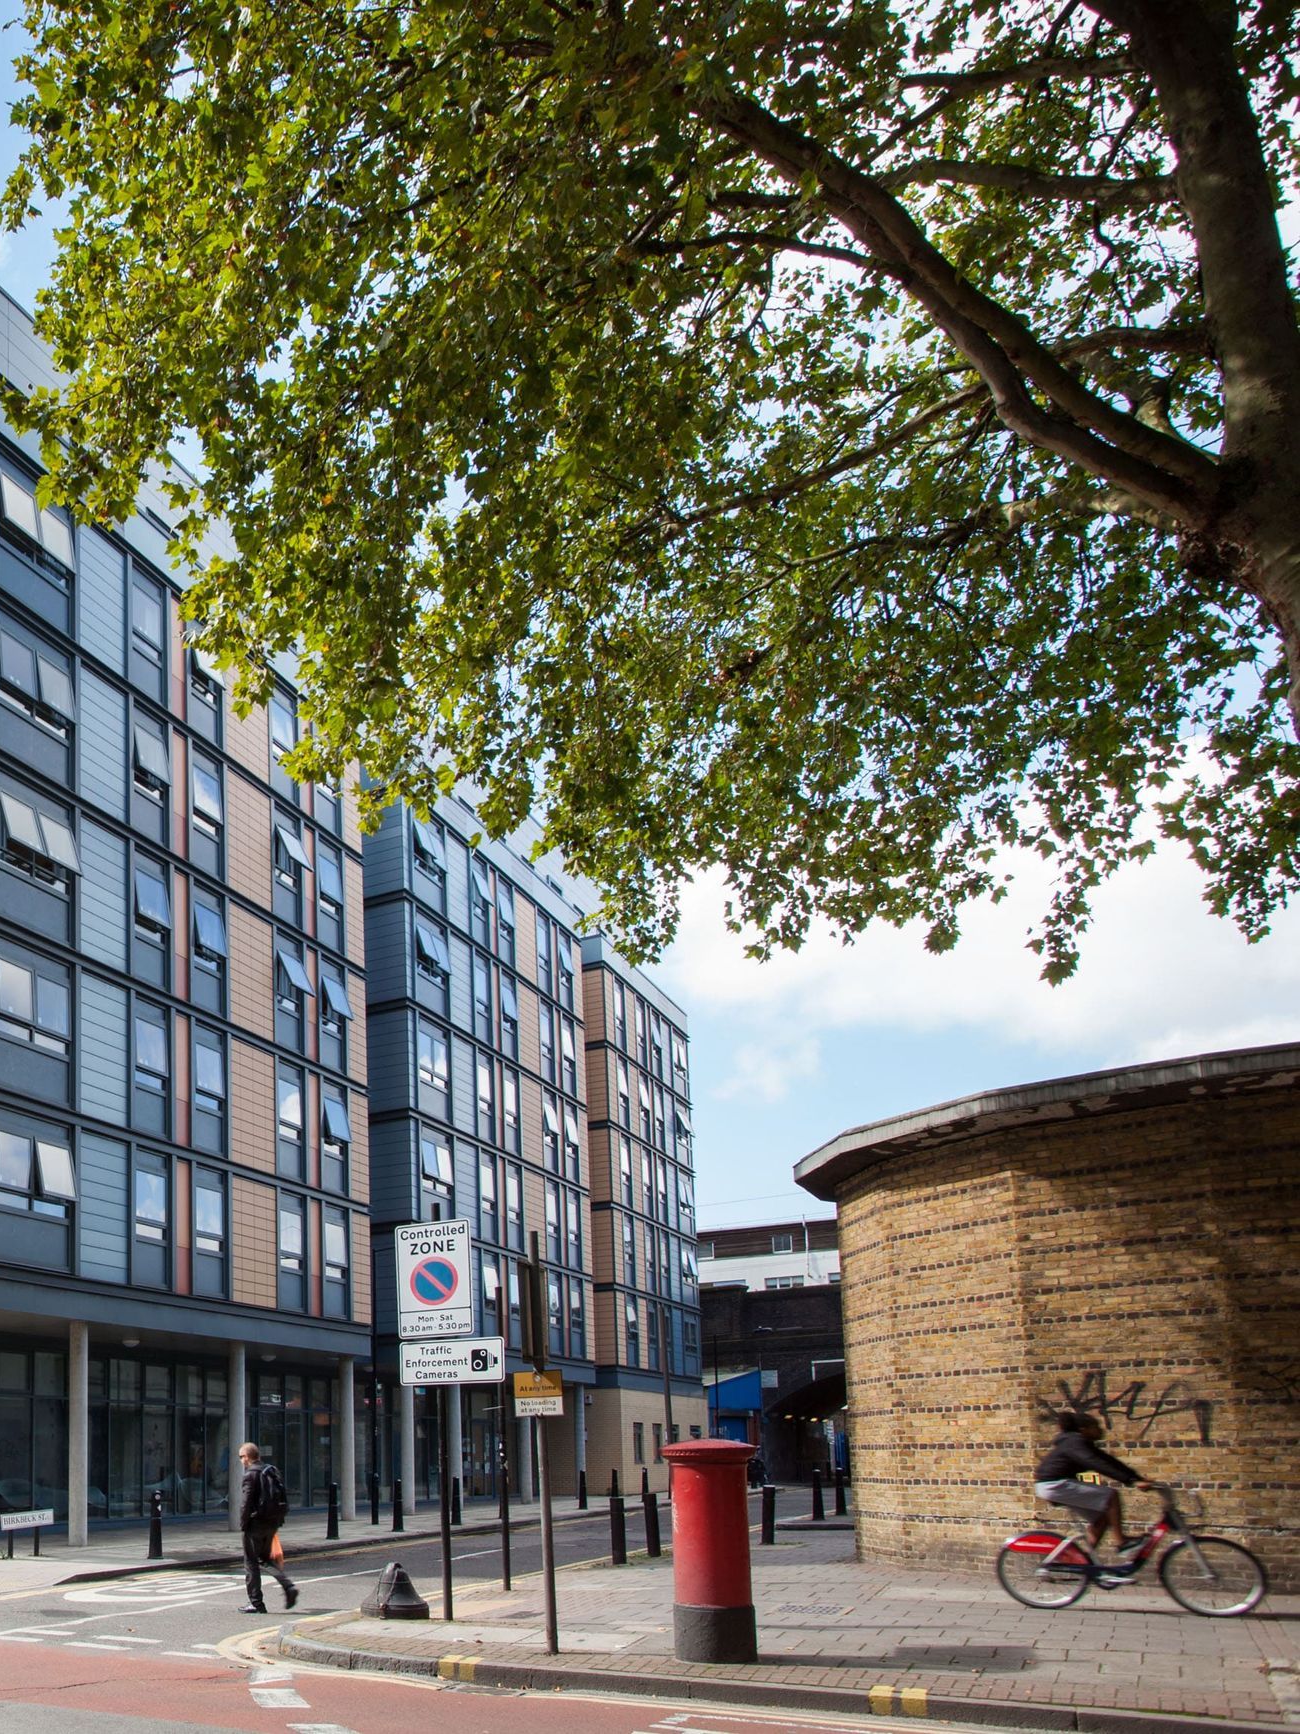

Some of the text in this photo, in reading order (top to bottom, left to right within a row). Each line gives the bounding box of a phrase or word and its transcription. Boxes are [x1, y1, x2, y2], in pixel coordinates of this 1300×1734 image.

[400, 1223, 465, 1240] Controlled
[410, 1239, 456, 1256] ZONE
[420, 1346, 452, 1355] Traffic
[405, 1356, 468, 1368] Enforcement
[415, 1371, 458, 1379] Cameras
[3, 1514, 36, 1525] BIRKBECK
